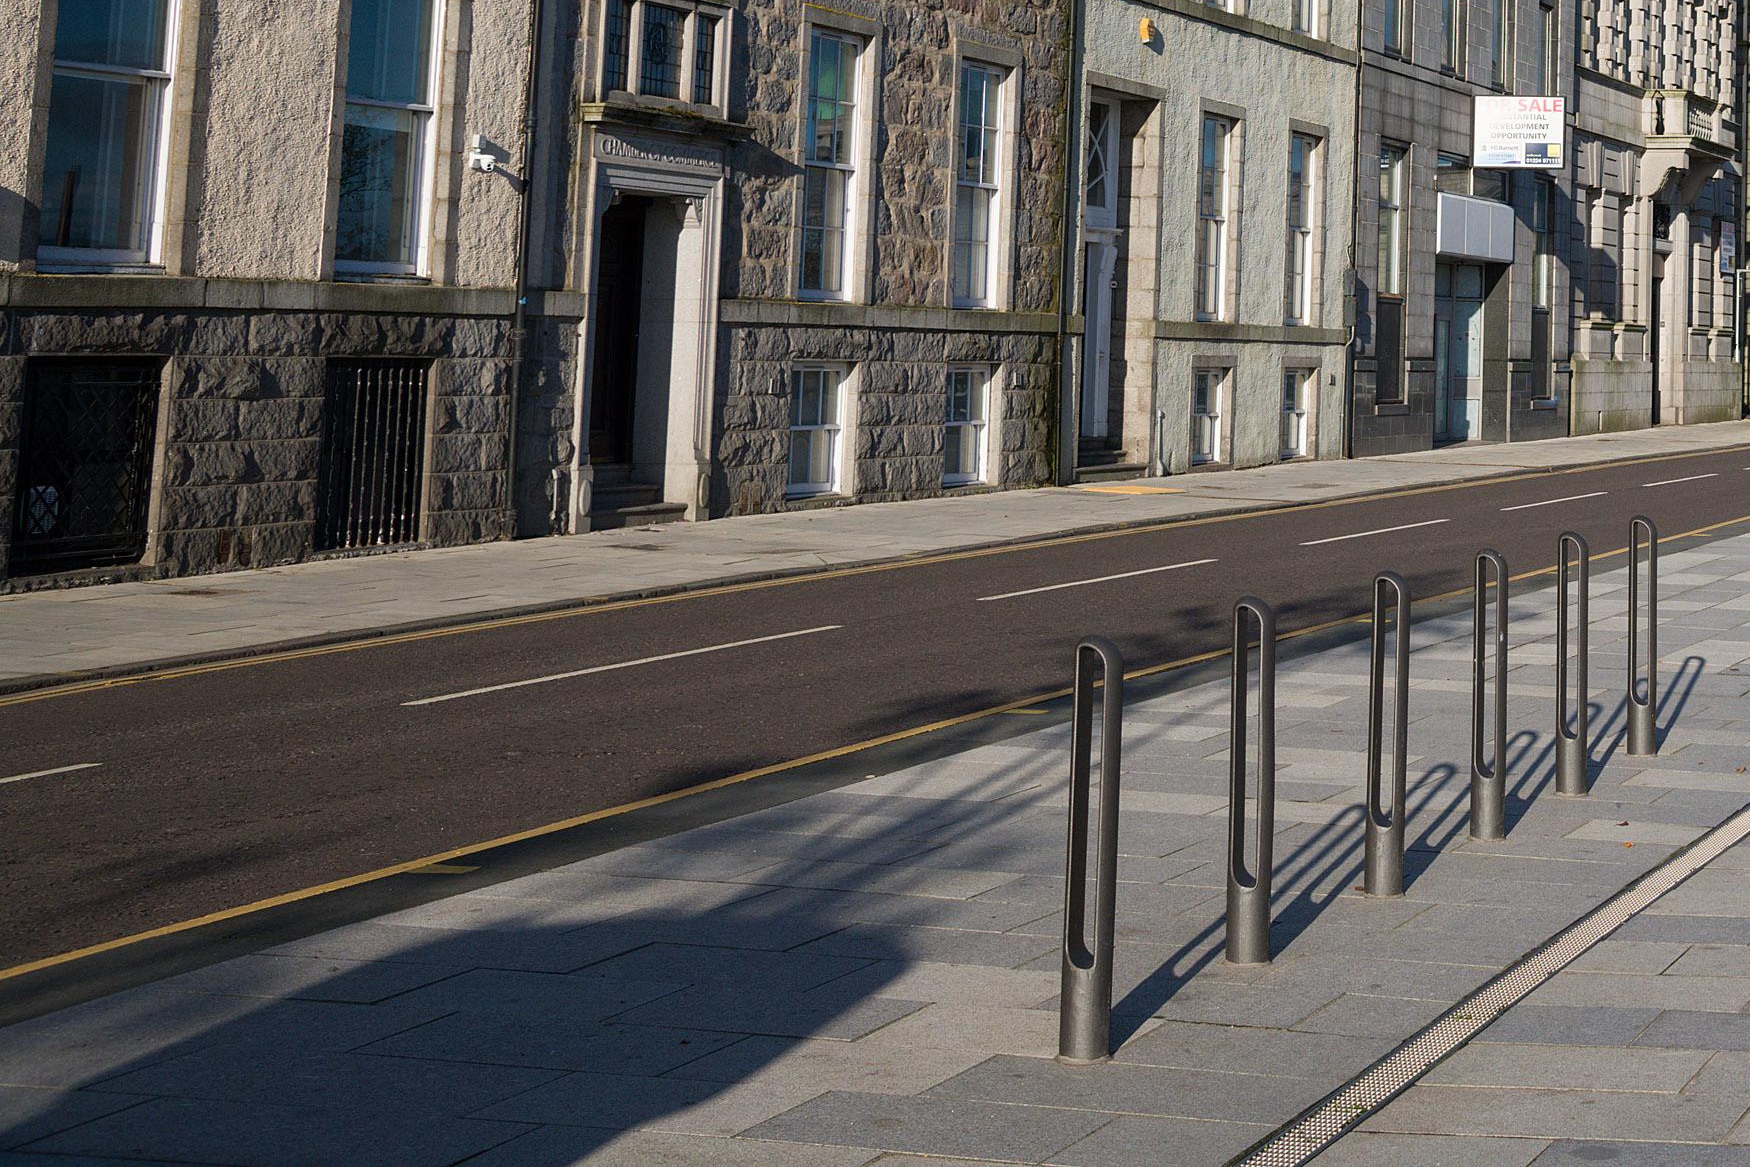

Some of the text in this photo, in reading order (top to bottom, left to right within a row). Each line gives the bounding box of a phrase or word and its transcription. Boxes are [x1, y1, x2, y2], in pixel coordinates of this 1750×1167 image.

[1518, 98, 1563, 112] SALE
[1490, 132, 1548, 140] OPPORTUNITY
[599, 136, 648, 161] CHAMBER
